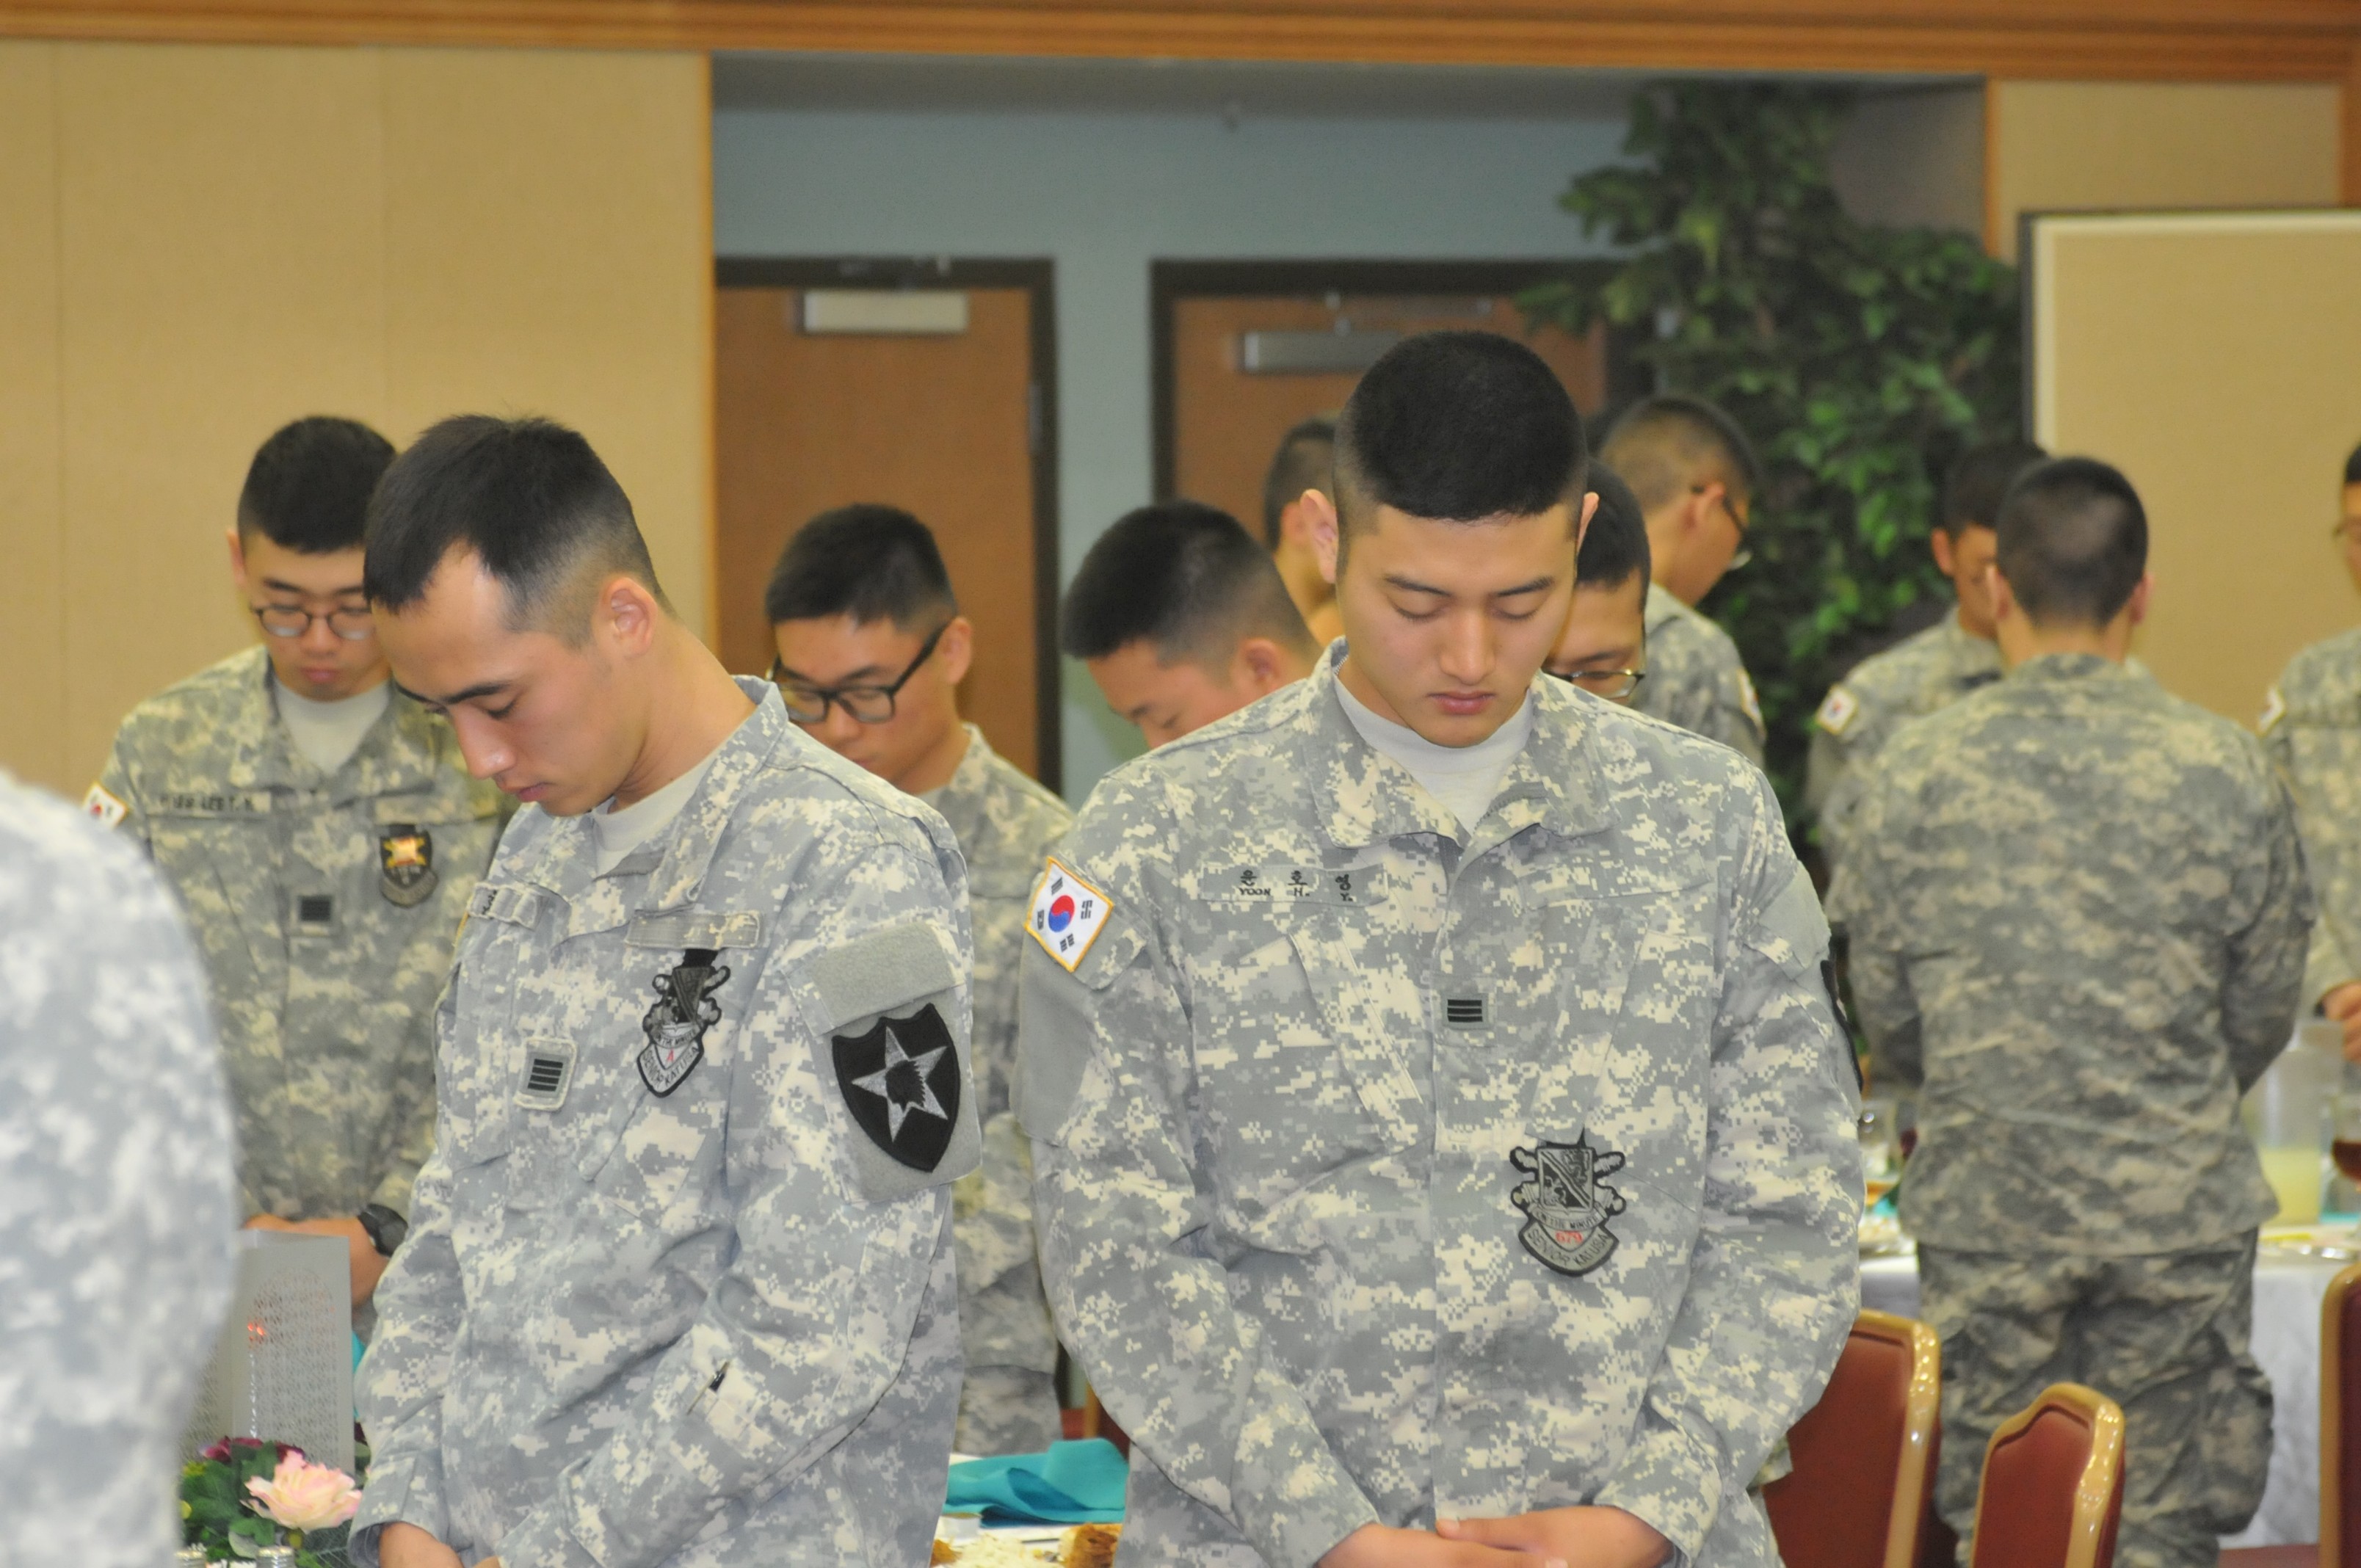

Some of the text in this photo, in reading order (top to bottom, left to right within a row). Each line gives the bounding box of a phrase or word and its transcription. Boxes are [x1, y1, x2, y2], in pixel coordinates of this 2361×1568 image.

[1238, 888, 1272, 896] YOON
[1294, 887, 1310, 897] H.
[1573, 1233, 1610, 1267] KATUSA
